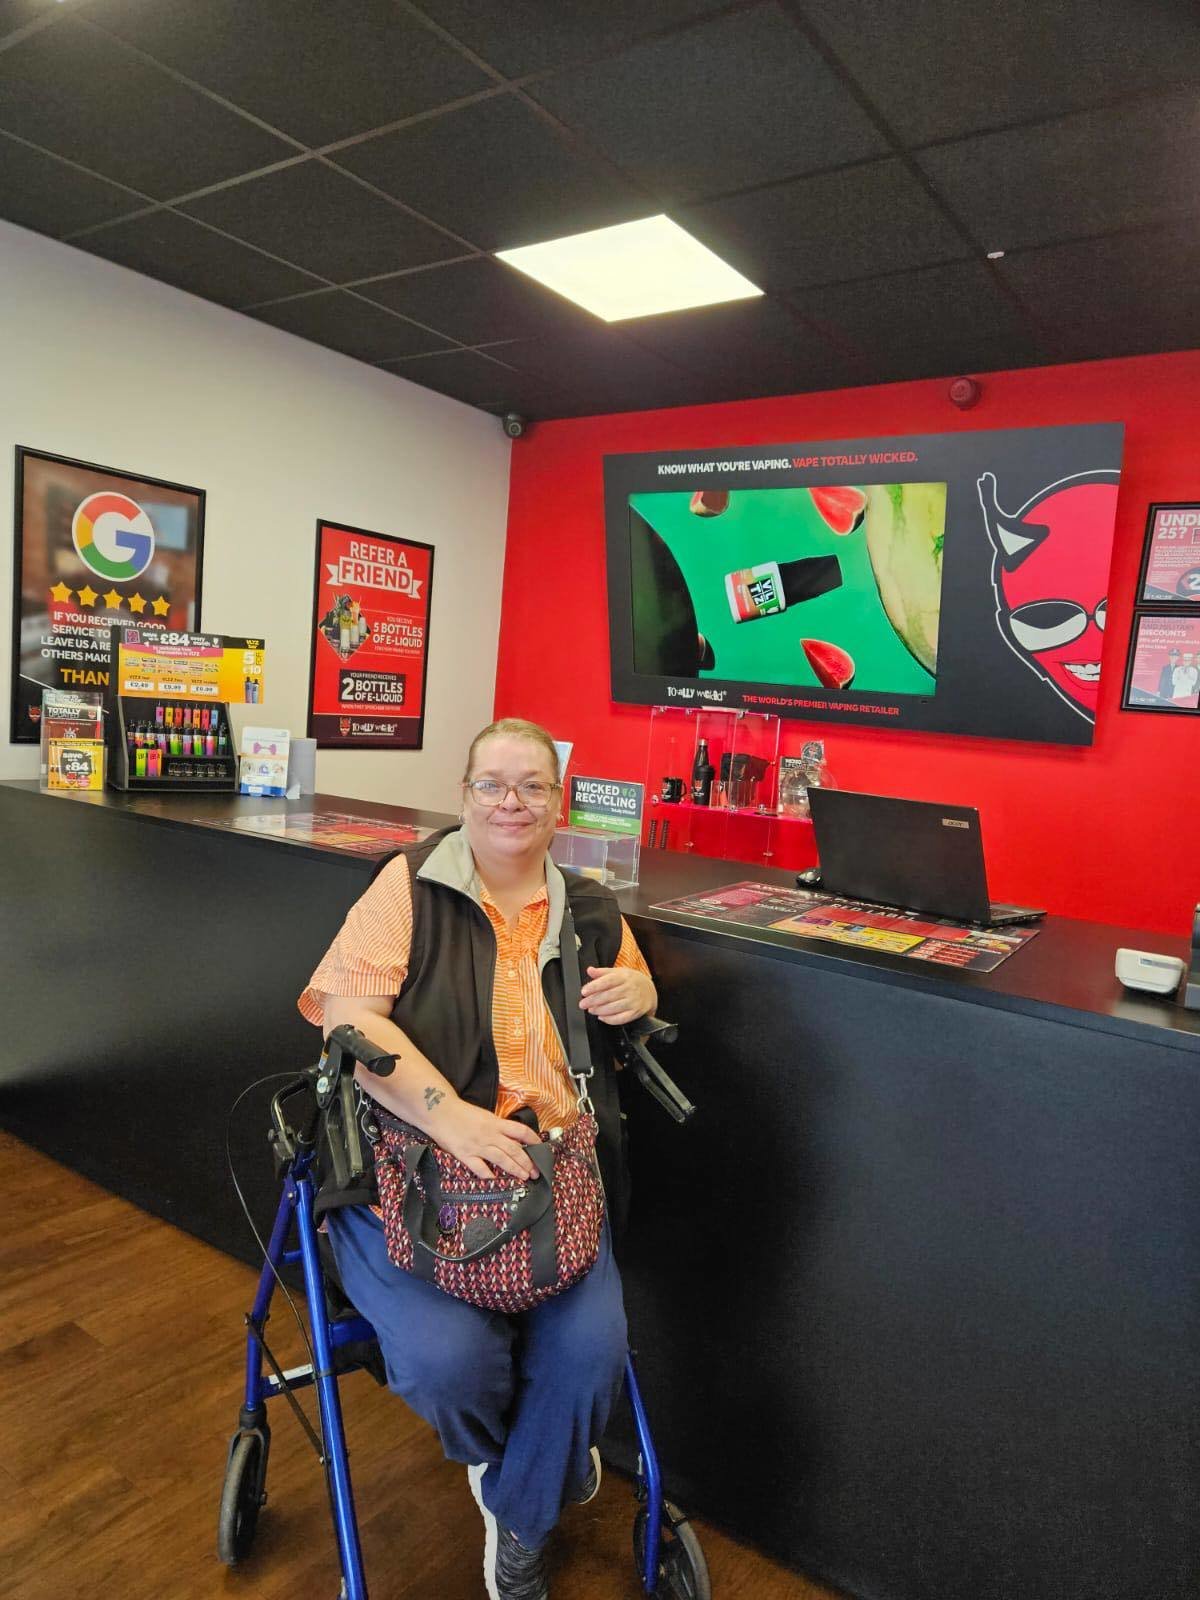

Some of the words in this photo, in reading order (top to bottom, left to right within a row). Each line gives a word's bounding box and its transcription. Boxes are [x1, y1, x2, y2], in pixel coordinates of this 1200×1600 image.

[658, 464, 687, 475] KNOW
[687, 462, 716, 474] WHAT
[716, 460, 751, 472] YOU'RE
[751, 459, 792, 470] VAPING.
[792, 456, 819, 468] VAPE
[819, 454, 868, 466] TOTALLY
[868, 451, 919, 464] WICKED.
[1158, 527, 1188, 540] 25?
[350, 540, 395, 566] REFER
[397, 551, 408, 568] A
[342, 560, 410, 590] FRIEND
[53, 611, 64, 622] IF
[65, 612, 87, 624] YOU
[88, 614, 135, 628] RECEIVED
[52, 624, 95, 637] SERVICE
[97, 627, 111, 639] TO
[373, 622, 379, 633] 5
[381, 622, 423, 638] BOTTLES
[41, 636, 73, 648] LEAVE
[75, 638, 89, 649] US
[90, 640, 98, 650] A
[99, 641, 111, 651] RE
[160, 632, 190, 646] £84
[373, 634, 385, 644] OF
[386, 635, 423, 648] E-LIQUID
[41, 648, 83, 661] OTHERS
[84, 653, 111, 663] MAK
[60, 668, 110, 686] THAN
[341, 677, 354, 700] 2
[355, 680, 403, 694] BOTTLES
[354, 692, 366, 701] OF
[367, 692, 403, 703] E-LIQUID
[742, 695, 758, 703] THE
[758, 696, 793, 707] WORLD'S
[793, 699, 827, 709] PREMIER
[828, 702, 859, 712] VAPING
[859, 704, 899, 715] RETAILER
[47, 707, 80, 715] TOTALLY
[577, 781, 620, 796] WICKED
[575, 791, 636, 809] RECYCLING
